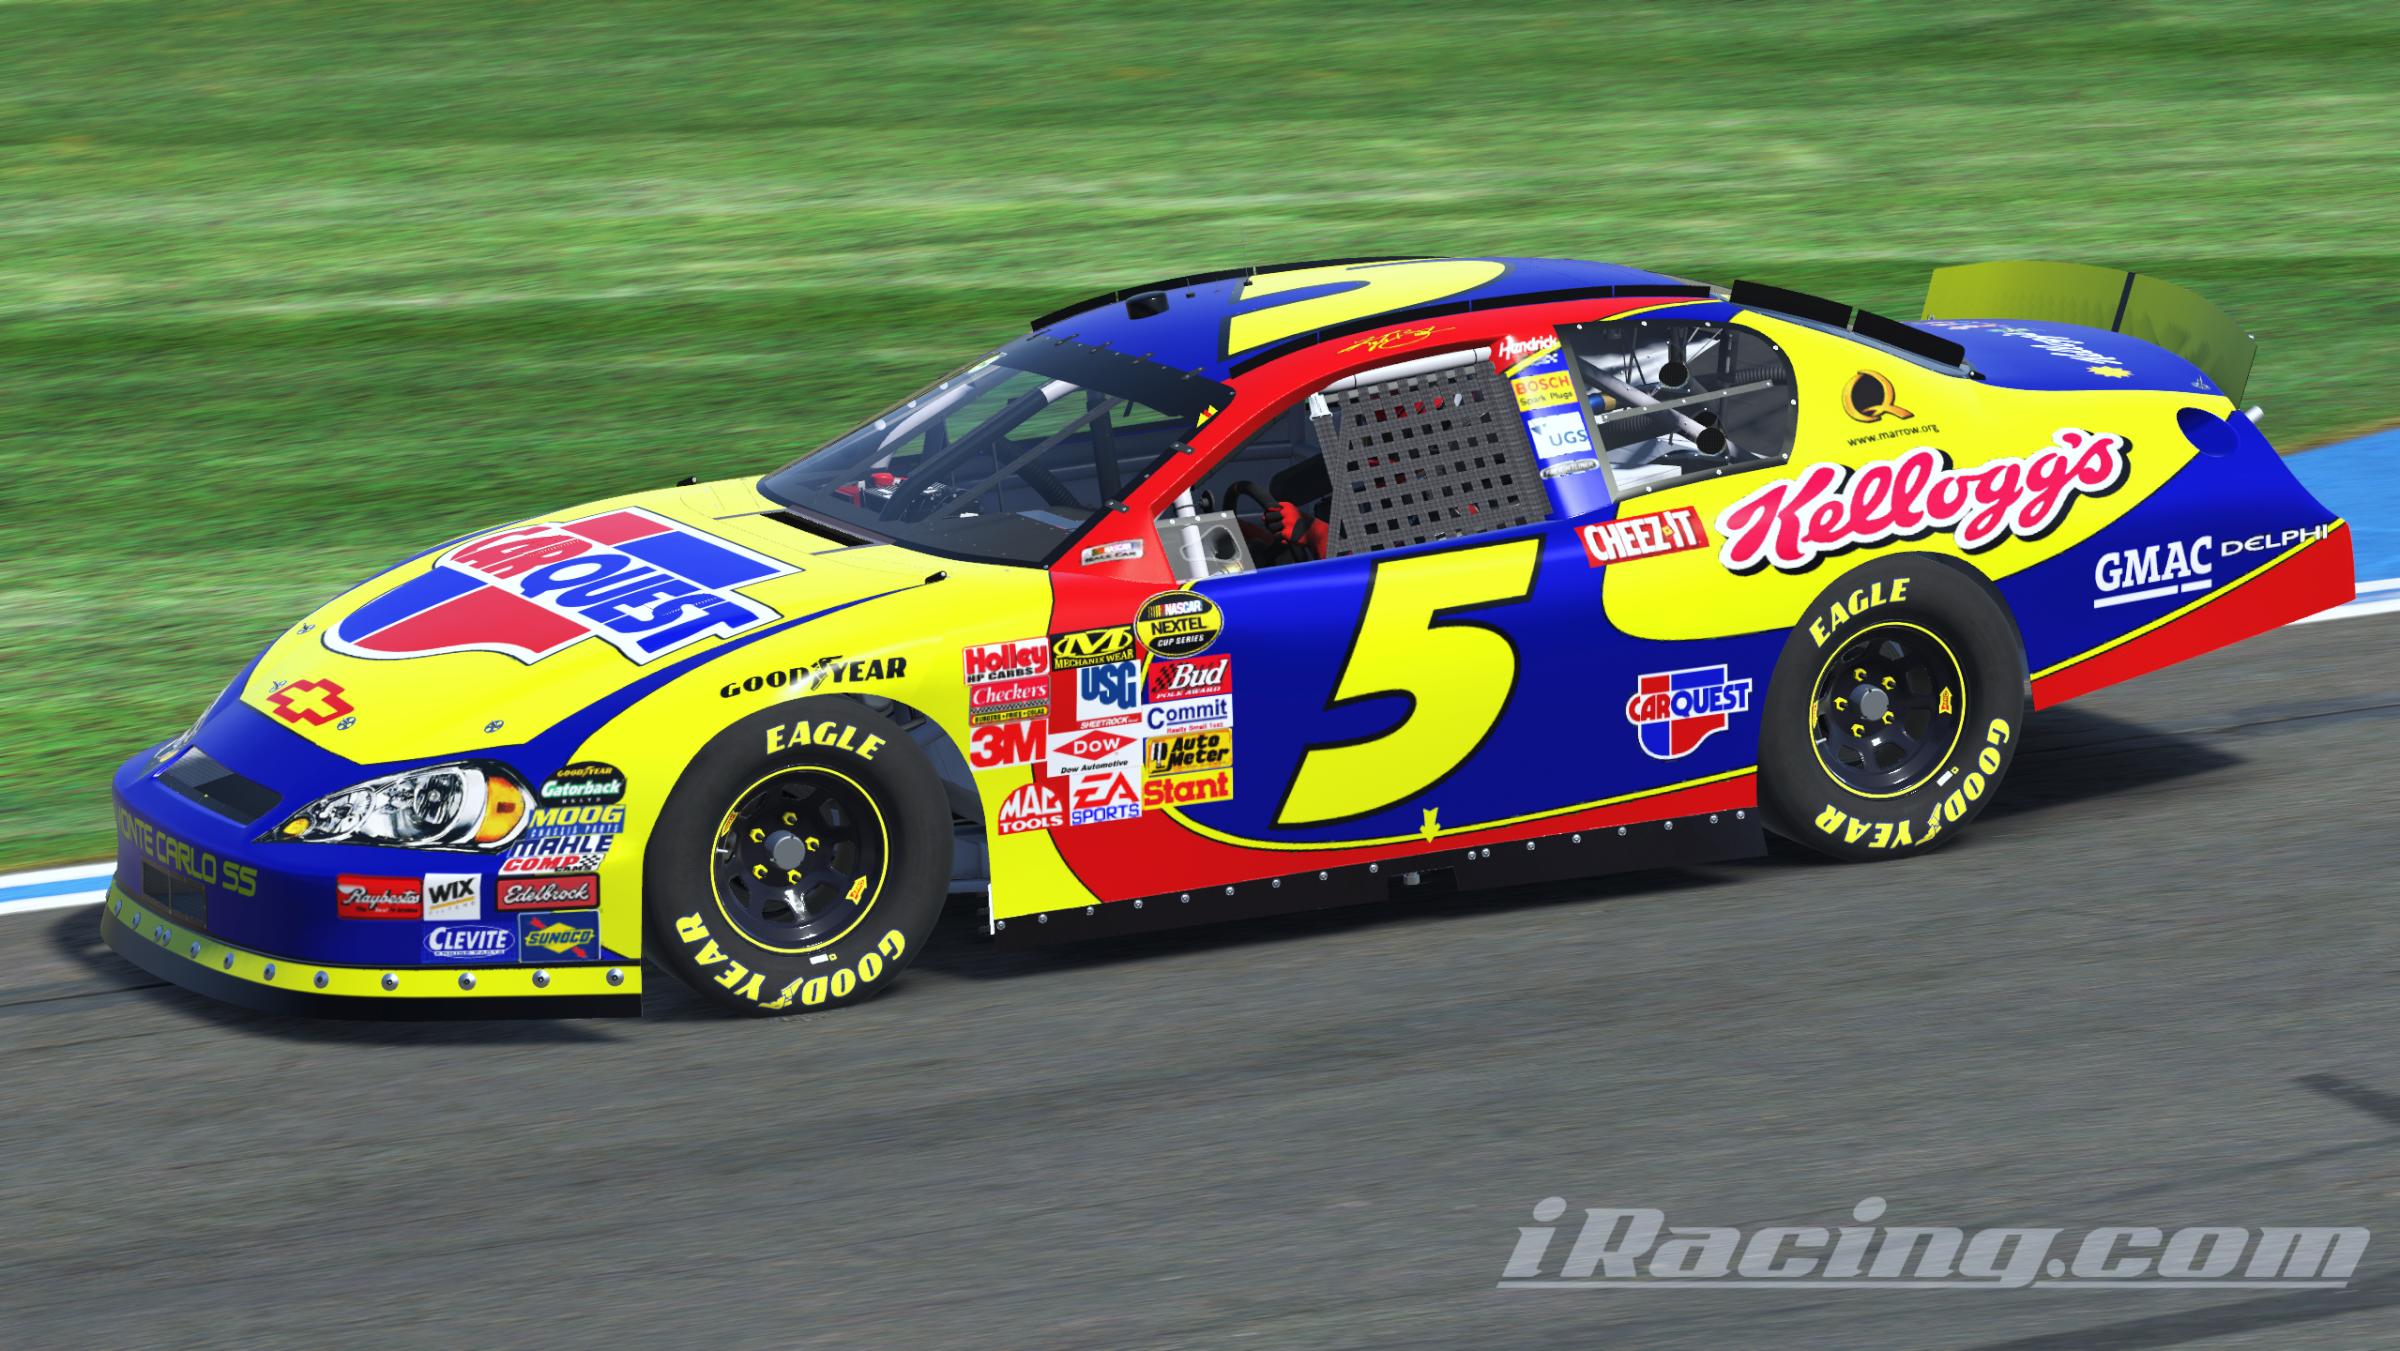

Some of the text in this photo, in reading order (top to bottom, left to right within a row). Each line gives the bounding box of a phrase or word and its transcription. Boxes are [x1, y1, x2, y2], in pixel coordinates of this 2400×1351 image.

[1515, 375, 1570, 395] BOSCH
[1519, 387, 1574, 407] Spark Plugs
[1549, 429, 1588, 446] UGS
[1847, 424, 1940, 446] www.marrow.org
[1720, 430, 2128, 574] Kellogg's
[2220, 523, 2330, 559] DELPHI
[2094, 536, 2213, 593] GMAC
[1164, 600, 1203, 617] NASCAR
[1809, 577, 1911, 648] EAGLE
[1151, 617, 1208, 635] NEXTEL
[1157, 634, 1205, 647] CUP SERIES
[965, 643, 1049, 675] Holley
[1053, 649, 1134, 670] MECHANIX WEAR
[720, 655, 908, 698] GOODYEAR
[988, 667, 1034, 681] CARBS
[1081, 661, 1137, 710] USG
[1168, 659, 1228, 690] Bud
[1273, 536, 1542, 827] 5
[973, 683, 1048, 705] Checkers
[1627, 681, 1752, 721] CARQUEST
[1080, 716, 1129, 730] SHEETROCK
[1147, 698, 1228, 730] Commit
[765, 720, 887, 761] EAGLE
[970, 720, 1047, 769] 3M
[1172, 734, 1221, 753] Auto
[1061, 759, 1129, 775] Dow Automotive
[1169, 748, 1230, 767] Meter
[541, 778, 623, 798] Gatorback
[1073, 771, 1140, 810] EA
[1144, 771, 1229, 806] Stant
[1000, 784, 1062, 818] MAC
[529, 805, 625, 829] MOOG
[1000, 815, 1064, 833] TOOLS
[1071, 803, 1140, 826] SPORTS
[119, 806, 257, 897] ONTE CARLO SS
[509, 834, 615, 859] MAHLE
[503, 855, 580, 872] COMP
[344, 883, 420, 910] Raybestos
[429, 877, 475, 904] WIX
[503, 884, 590, 905] Edelbrock
[429, 926, 508, 951] CLEVITE
[525, 929, 594, 946] SUNOCO
